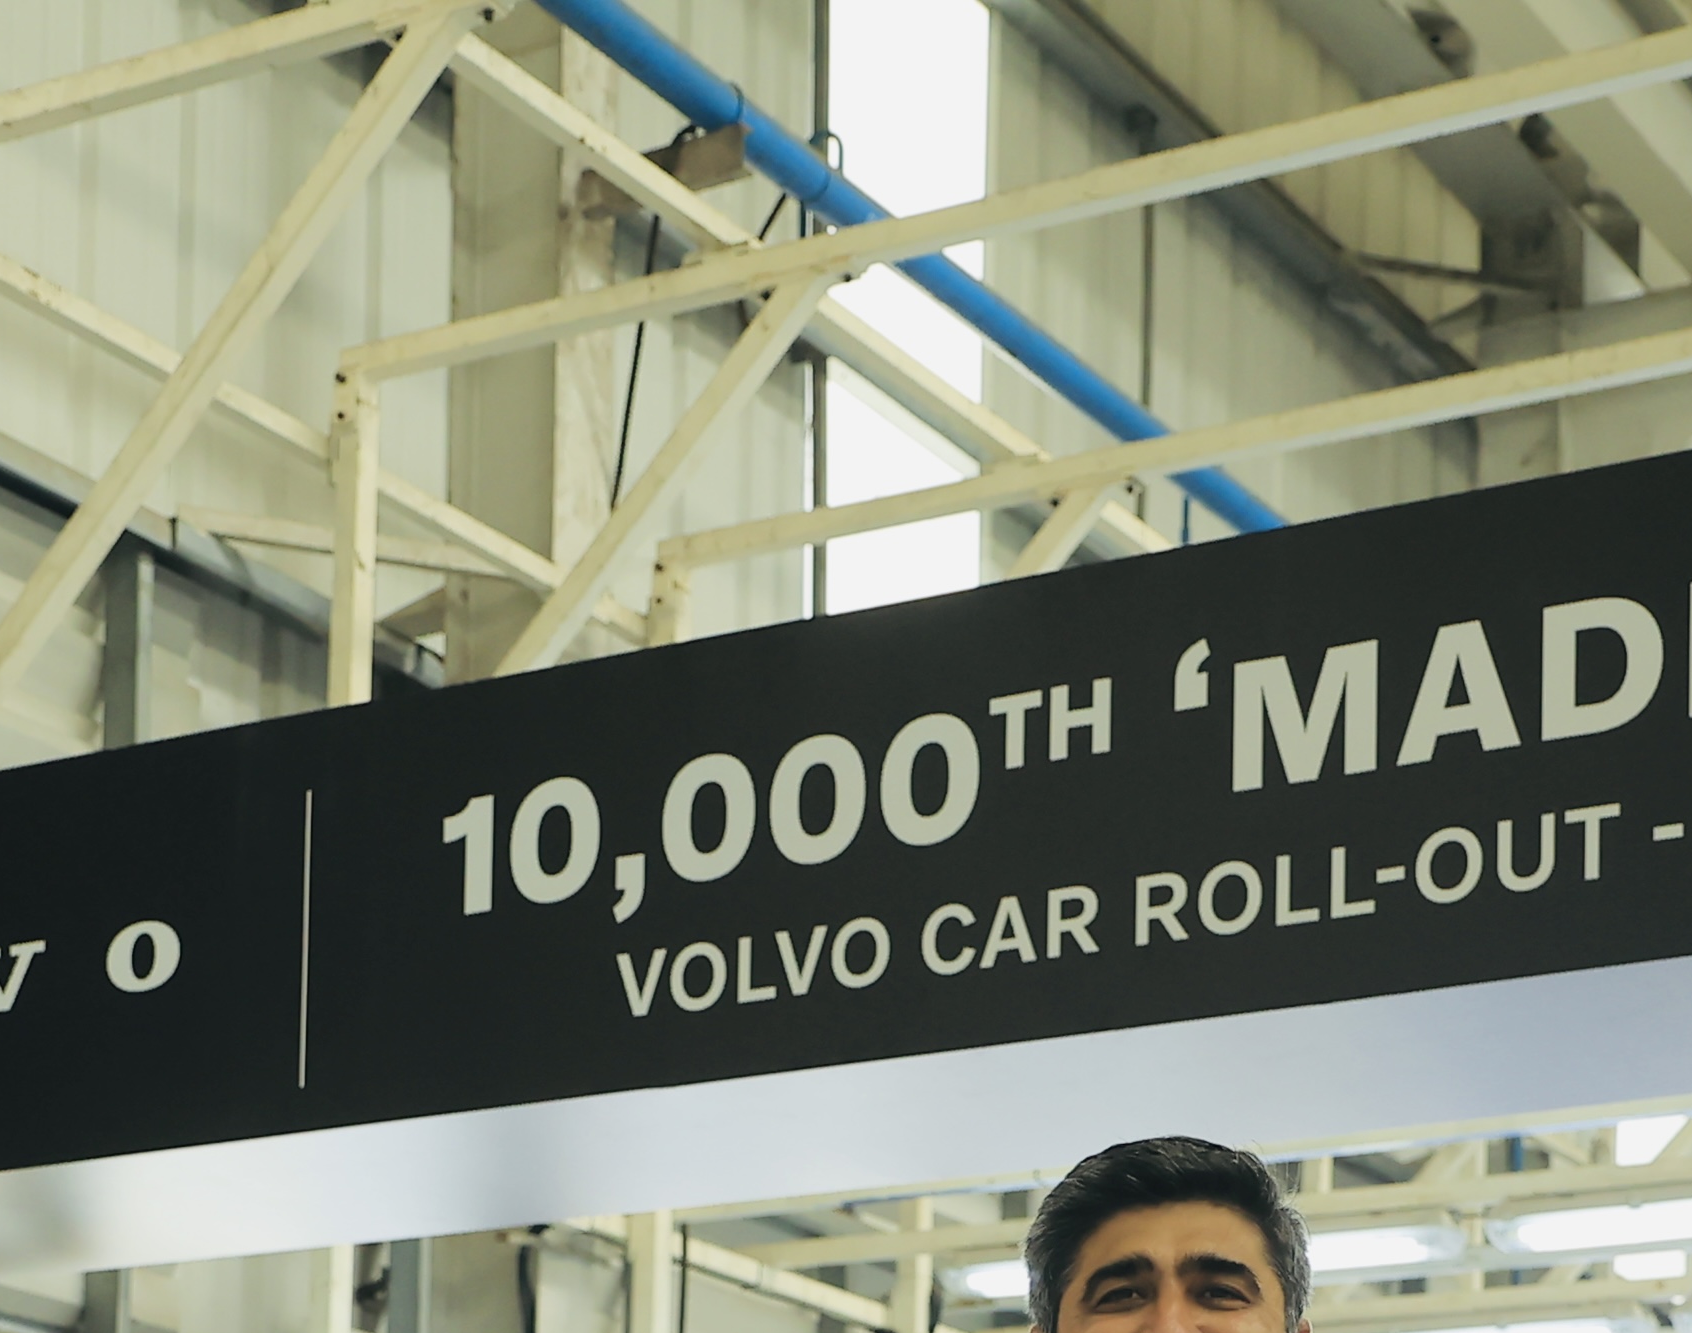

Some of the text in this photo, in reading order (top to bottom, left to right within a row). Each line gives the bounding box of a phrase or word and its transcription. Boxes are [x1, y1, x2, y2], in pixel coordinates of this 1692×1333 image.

[616, 917, 891, 1017] VOLVO
[921, 885, 1101, 976] CAR
[1134, 802, 1622, 947] ROLL-OUT
[1652, 822, 1685, 842] -
